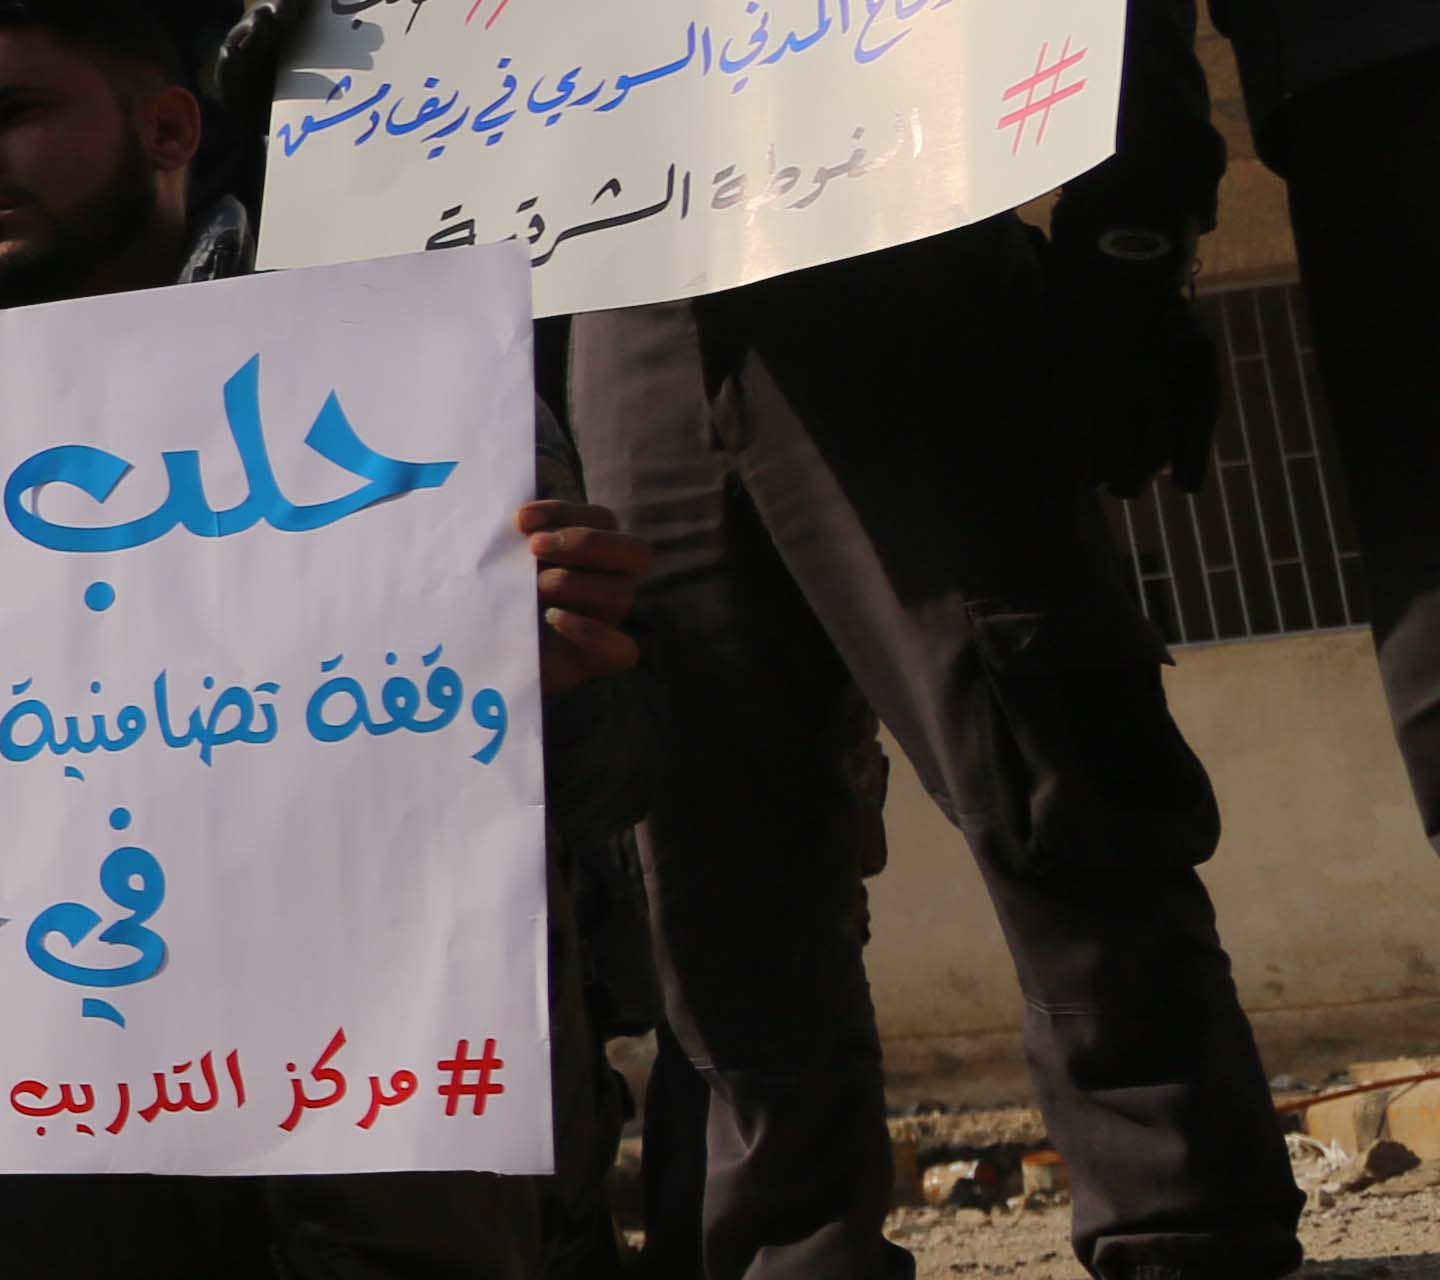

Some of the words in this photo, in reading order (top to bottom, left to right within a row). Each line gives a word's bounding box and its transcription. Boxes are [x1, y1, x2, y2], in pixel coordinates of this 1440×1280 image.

[277, 75, 392, 157] دمشق
[386, 77, 470, 159] ريف
[471, 58, 518, 145] في
[527, 21, 711, 126] السوري
[3, 353, 459, 613] حلب
[305, 643, 509, 765] وقفة
[25, 806, 167, 1029] في
[10, 1048, 247, 1138] التدريب
